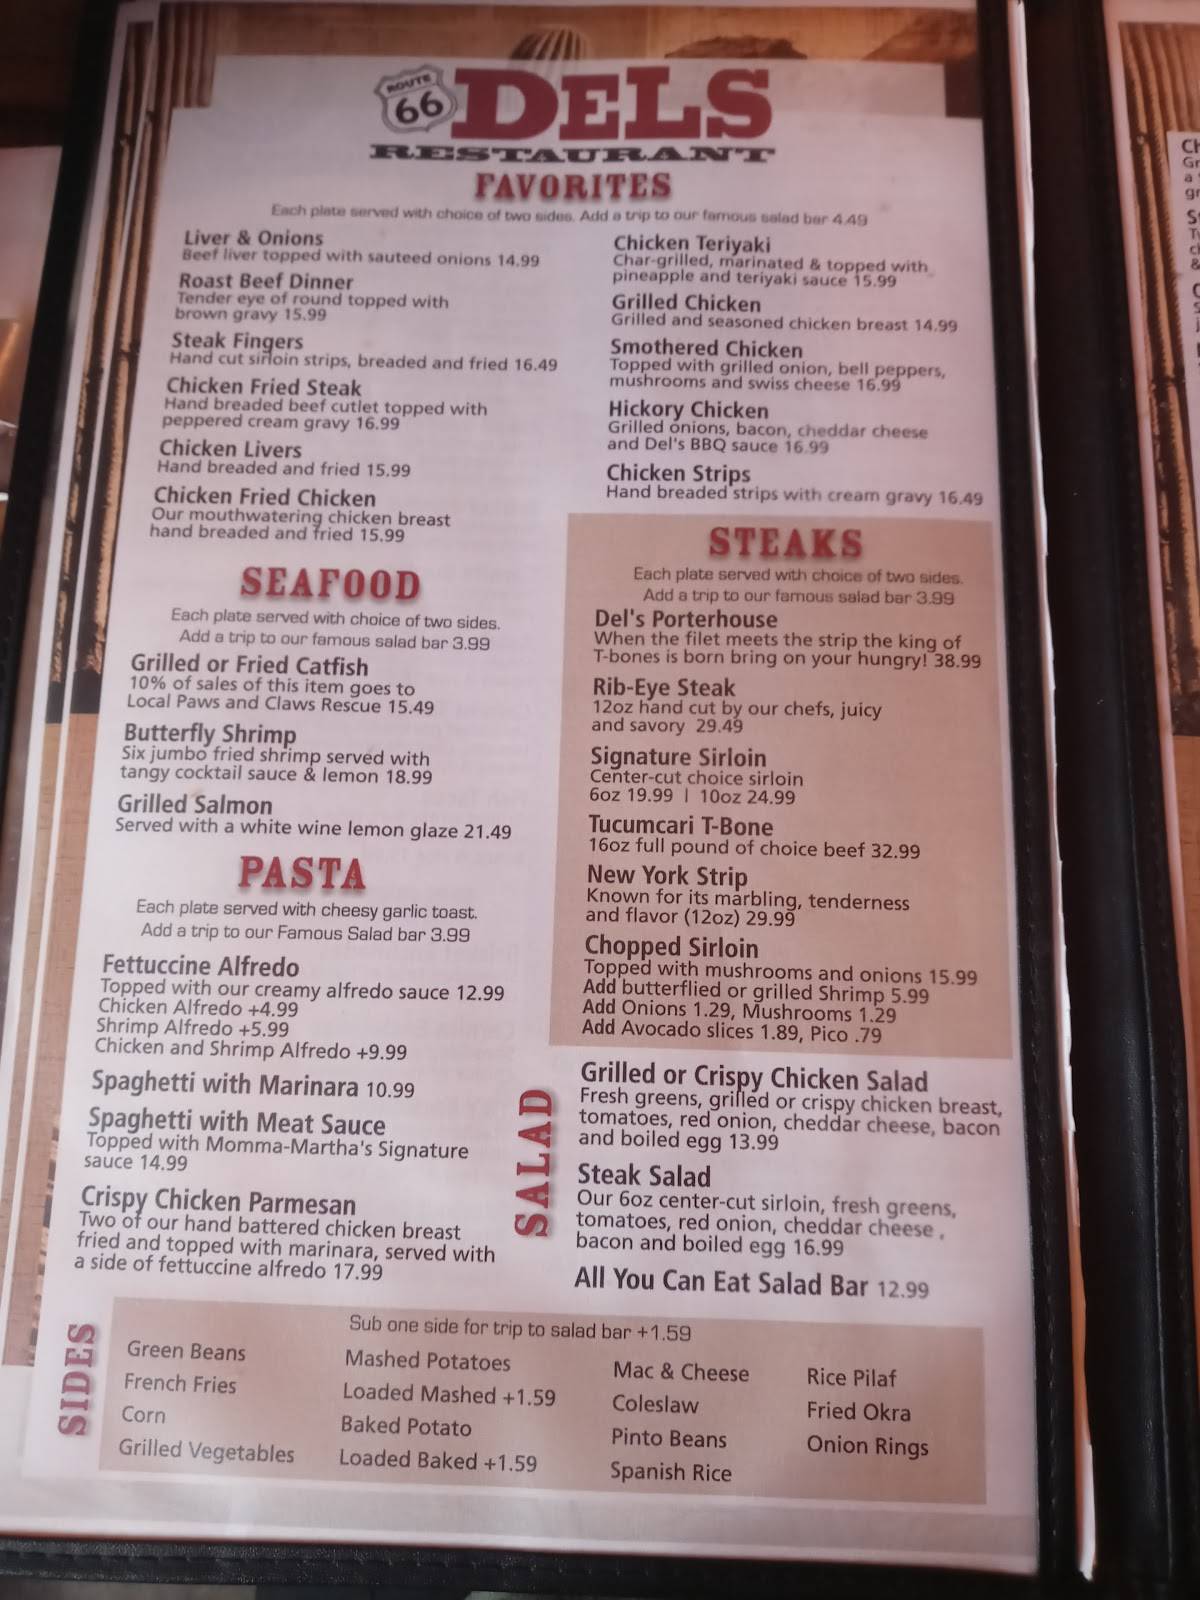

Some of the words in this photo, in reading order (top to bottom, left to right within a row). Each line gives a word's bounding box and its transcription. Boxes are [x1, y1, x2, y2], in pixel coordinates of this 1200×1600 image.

[386, 72, 433, 97] ROUTE
[395, 91, 445, 125] 66
[450, 66, 773, 141] DELS
[369, 144, 776, 163] RESTAURANT
[475, 172, 673, 200] FAVORITES
[184, 230, 229, 246] Liver
[236, 231, 250, 246] &
[257, 231, 323, 247] Onions
[613, 235, 689, 252] Chicken
[697, 236, 770, 257] Teriyaki
[179, 273, 232, 289] Roast
[239, 273, 282, 290] Beef
[289, 274, 354, 290] Dinner
[612, 294, 677, 311] Grilled
[684, 295, 761, 312] Chicken
[611, 313, 666, 327] Grilled
[671, 314, 702, 328] and
[708, 315, 783, 329] seasoned
[788, 316, 851, 331] chicken
[856, 318, 907, 332] breast
[915, 319, 957, 333] 14.99
[172, 332, 225, 349] Steak
[233, 332, 303, 355] Fingers
[610, 339, 718, 357] Smothered
[725, 340, 802, 358] Chicken
[166, 377, 243, 396] Chicken
[250, 378, 300, 396] Fried
[306, 379, 360, 397] Steak
[609, 400, 684, 422] Hickory
[690, 401, 768, 419] Chicken
[159, 439, 237, 458] Chicken
[244, 440, 301, 459] Livers
[157, 459, 202, 474] Hand
[207, 459, 277, 476] breaded
[282, 461, 315, 476] and
[320, 461, 360, 477] fried
[367, 462, 410, 478] 15.99
[606, 464, 685, 482] Chicken
[692, 465, 750, 487] Strips
[154, 485, 232, 505] Chicken
[239, 487, 290, 506] Fried
[297, 488, 376, 507] Chicken
[709, 526, 863, 559] STEAKS
[240, 566, 422, 600] SEAFOOD
[595, 610, 644, 627] Del's
[652, 610, 777, 628] Porterhouse
[130, 654, 200, 673] Grilled
[206, 659, 229, 673] or
[236, 656, 288, 675] Fried
[295, 658, 368, 676] Catfish
[593, 678, 670, 701] Rib-Eye
[677, 679, 735, 696] Steak
[127, 695, 170, 709] Local
[176, 696, 220, 710] Paws
[225, 697, 259, 711] and
[264, 697, 315, 712] Claws
[321, 699, 381, 714] Rescue
[389, 700, 434, 715] 15.49
[124, 724, 215, 747] Butterfly
[222, 725, 296, 749] Shrimp
[591, 717, 624, 732] and
[629, 721, 685, 737] savory
[696, 719, 743, 734] 29.49
[591, 746, 691, 770] Signature
[699, 748, 766, 766] Sirloin
[117, 795, 187, 814] Grilled
[194, 796, 272, 815] Salmon
[588, 815, 693, 835] Tucumcari
[702, 816, 773, 836] T-Bone
[589, 837, 630, 854] 16oz
[635, 838, 664, 854] full
[671, 839, 728, 859] pound
[735, 840, 753, 856] of
[759, 840, 817, 857] choice
[824, 841, 865, 858] beef
[871, 842, 920, 858] 32.99
[238, 856, 366, 890] PASTA
[588, 865, 635, 885] New
[643, 866, 688, 885] York
[696, 866, 747, 891] Strip
[585, 935, 680, 962] Chopped
[689, 937, 758, 958] Sirloin
[103, 954, 211, 976] Fettuccine
[217, 956, 299, 977] Alfredo
[98, 997, 167, 1014] Chicken
[172, 999, 242, 1016] Alfredo
[248, 1000, 298, 1017] +4.99
[92, 1071, 194, 1097] Spaghetti
[202, 1073, 250, 1094] with
[259, 1075, 358, 1096] Marinara
[367, 1077, 414, 1098] 10.99
[581, 1063, 655, 1084] Grilled
[663, 1069, 687, 1085] or
[694, 1066, 763, 1092] Crispy
[770, 1068, 858, 1089] Chicken
[867, 1070, 927, 1091] Salad
[89, 1108, 191, 1135] Spaghetti
[199, 1110, 248, 1131] with
[256, 1112, 313, 1133] Meat
[321, 1113, 385, 1135] Sauce
[578, 1129, 614, 1146] and
[621, 1130, 679, 1147] boiled
[686, 1135, 721, 1152] egg
[730, 1133, 778, 1149] 13.99
[513, 1089, 553, 1238] SALAD
[578, 1163, 640, 1185] Steak
[649, 1165, 710, 1186] Salad
[81, 1185, 148, 1213] Crispy
[155, 1187, 240, 1211] Chicken
[249, 1190, 355, 1214] Parmesan
[574, 1267, 604, 1288] All
[614, 1268, 654, 1290] You
[662, 1270, 704, 1291] Can
[714, 1271, 750, 1292] Eat
[758, 1272, 821, 1294] Salad
[831, 1274, 868, 1296] Bar
[878, 1276, 928, 1297] 12.99
[127, 1340, 183, 1360] Green
[190, 1342, 245, 1362] Beans
[345, 1350, 419, 1369] Mashed
[427, 1352, 510, 1372] Potatoes
[58, 1324, 95, 1436] SIDES
[124, 1373, 186, 1393] French
[193, 1375, 236, 1394] Fries
[614, 1362, 653, 1380] Mac
[660, 1363, 674, 1380] &
[681, 1364, 749, 1383] Cheese
[807, 1369, 846, 1386] Rice
[853, 1370, 896, 1388] Pilaf
[343, 1383, 413, 1403] Loaded
[421, 1385, 496, 1405] Mashed
[503, 1388, 555, 1406] +1.59
[612, 1395, 699, 1415] Coleslaw
[121, 1405, 165, 1424] Corn
[807, 1403, 856, 1421] Fried
[863, 1404, 911, 1422] Okra
[341, 1416, 400, 1435] Baked
[407, 1418, 472, 1437] Potato
[612, 1429, 662, 1447] Pinto
[670, 1430, 726, 1449] Beans
[807, 1436, 868, 1454] Onion
[875, 1438, 928, 1460] Rings
[118, 1438, 182, 1458] Grilled
[188, 1441, 294, 1468] Vegetables
[339, 1448, 410, 1468] Loaded
[418, 1451, 477, 1471] Baked
[484, 1453, 537, 1473] +1.59
[610, 1461, 685, 1485] Spanish
[693, 1464, 732, 1482] Rice
